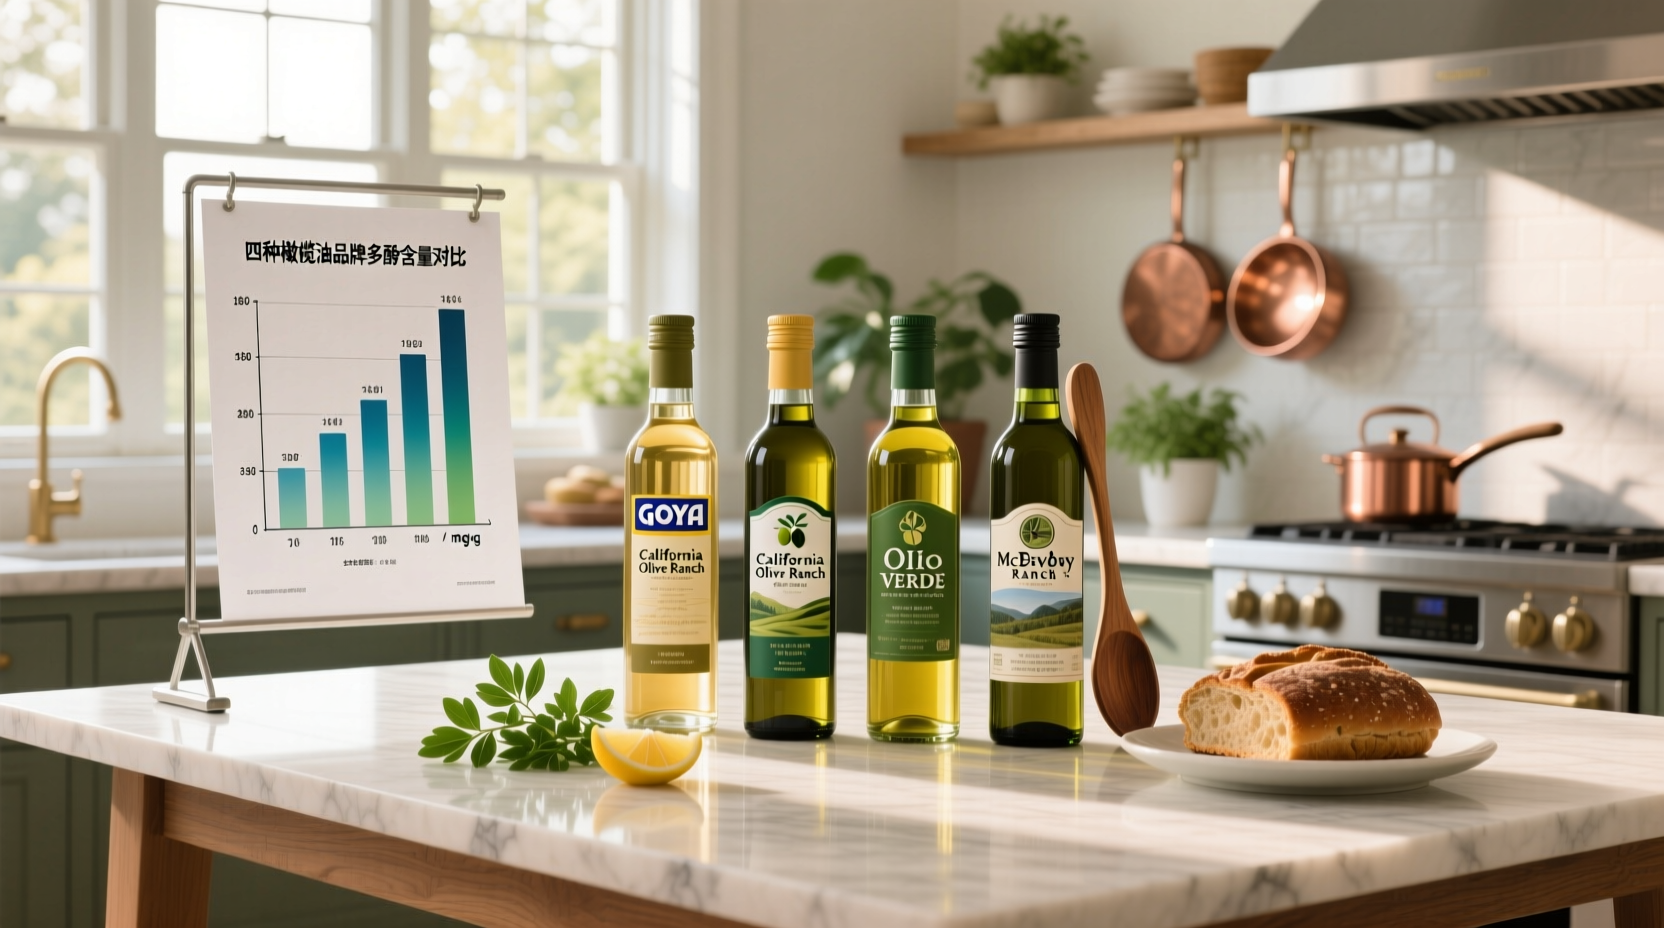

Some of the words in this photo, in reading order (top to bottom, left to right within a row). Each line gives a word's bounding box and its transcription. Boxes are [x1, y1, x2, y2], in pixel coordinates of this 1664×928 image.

[638, 503, 704, 527] GOYA
[252, 524, 258, 534] 0
[639, 548, 703, 561] California
[756, 552, 824, 566] California
[639, 562, 667, 574] Olive
[670, 562, 705, 574] Ranch
[789, 567, 825, 579] Ranch
[879, 572, 945, 589] VERDE
